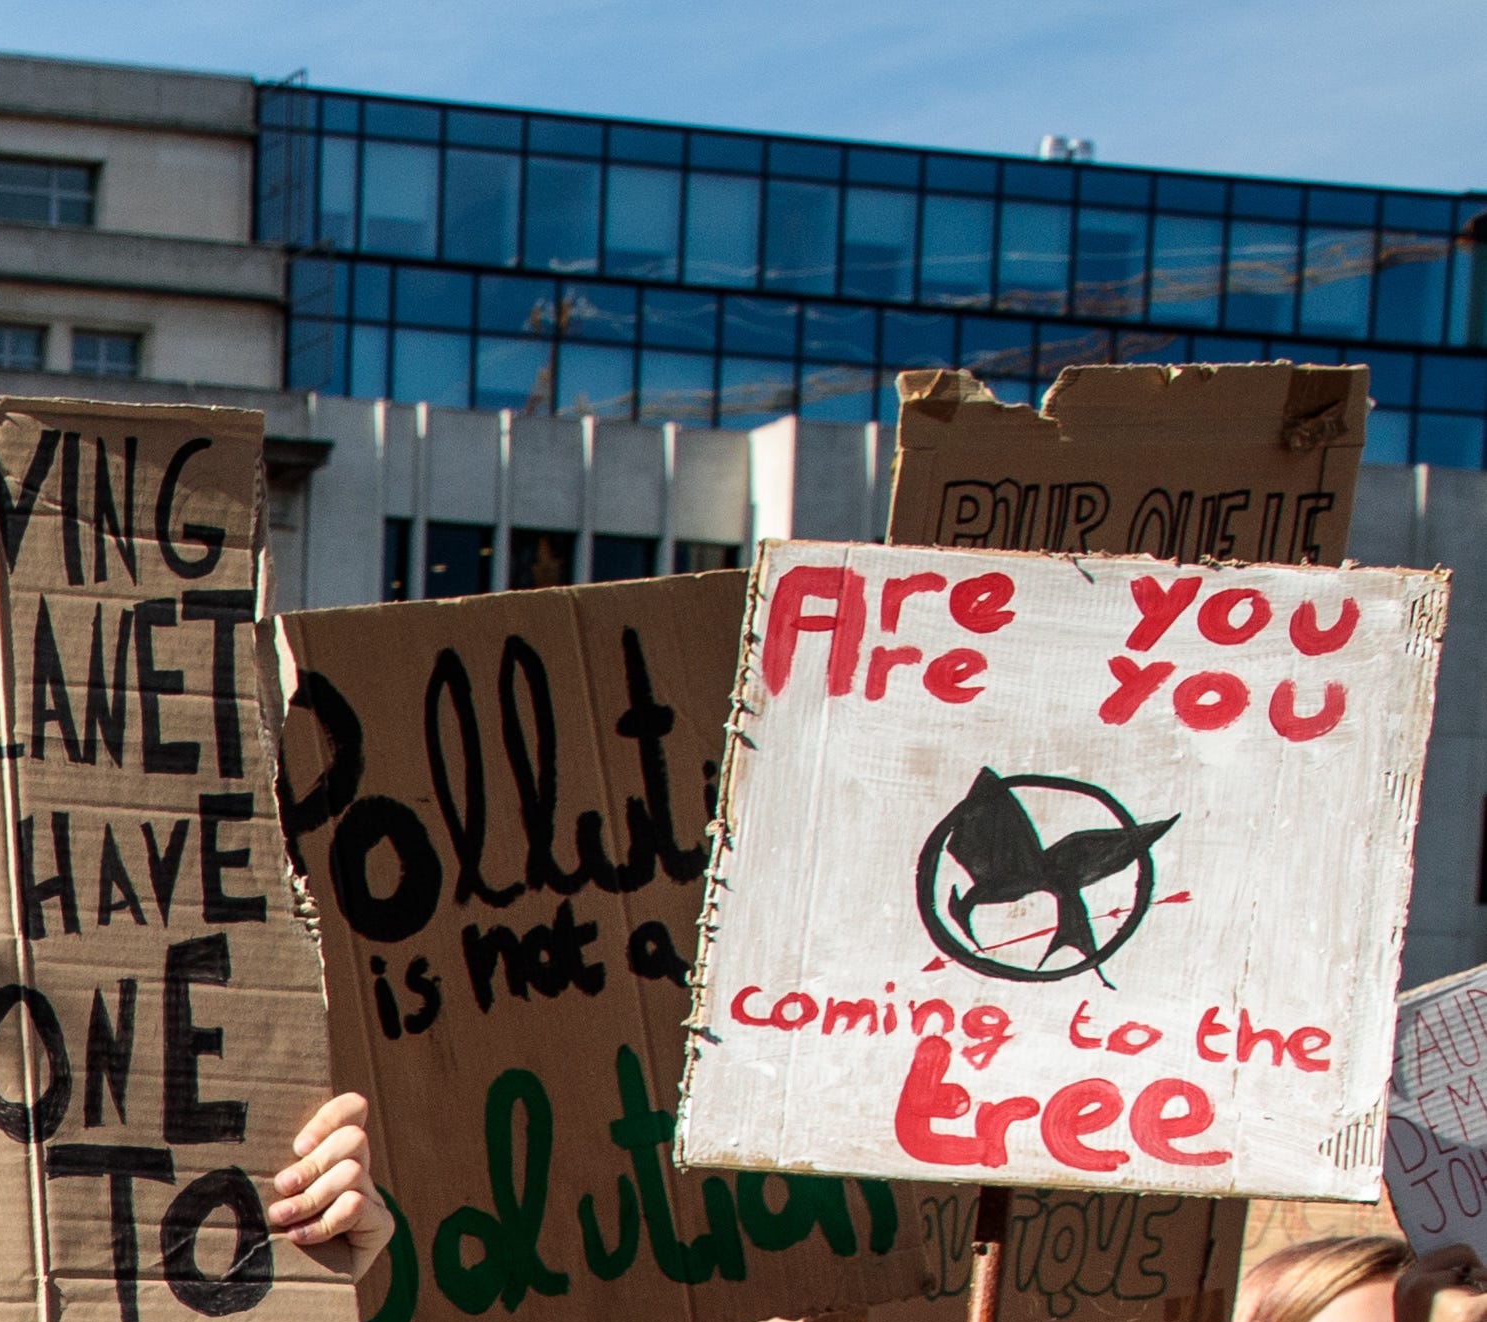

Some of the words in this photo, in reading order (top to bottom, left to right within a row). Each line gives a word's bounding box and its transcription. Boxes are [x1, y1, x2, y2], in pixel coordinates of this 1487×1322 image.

[1132, 574, 1360, 657] you
[1097, 655, 1349, 743] you
[277, 626, 718, 943] Polluti
[16, 792, 267, 941] HAVE
[369, 954, 443, 1042] is
[461, 898, 606, 1015] not
[729, 981, 1013, 1071] coming
[1069, 1000, 1164, 1057] to
[1196, 1006, 1333, 1073] the
[893, 1035, 1233, 1170] tree
